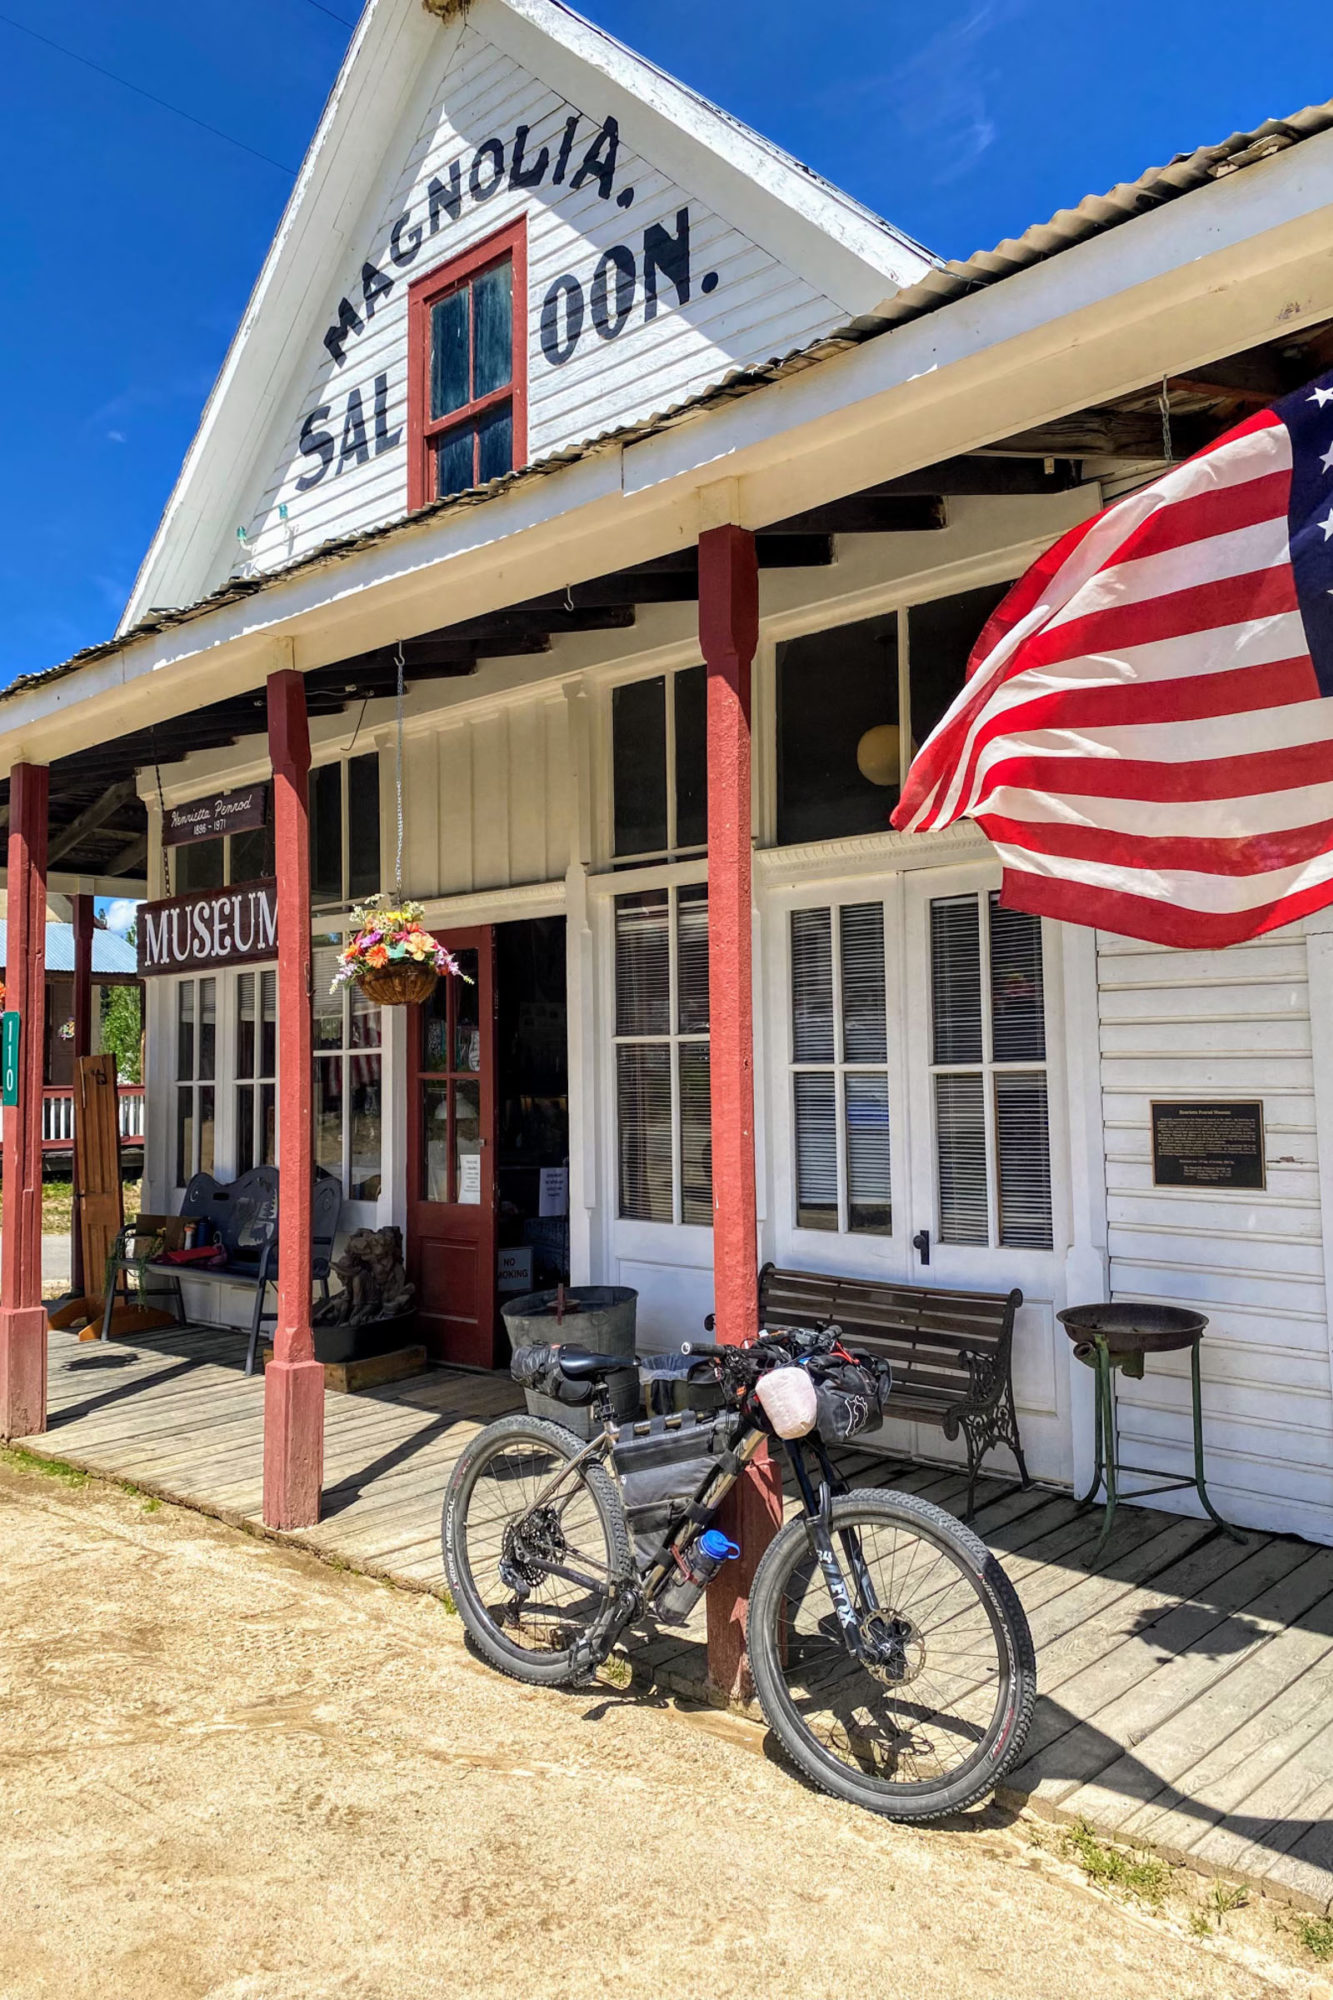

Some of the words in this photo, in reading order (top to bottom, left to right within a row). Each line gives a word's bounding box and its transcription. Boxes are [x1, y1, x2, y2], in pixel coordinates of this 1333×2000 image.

[323, 115, 635, 368] MAGNOLIA.
[295, 373, 403, 493] SAL
[171, 808, 211, 827] Henrietta
[214, 794, 252, 817] Penrod
[213, 819, 227, 832] 1971
[145, 891, 279, 966] MUSEUM
[6, 1020, 14, 1092] 110
[503, 1257, 516, 1267] NO
[446, 1499, 456, 1549] MEZCAL
[830, 1580, 857, 1629] FOX
